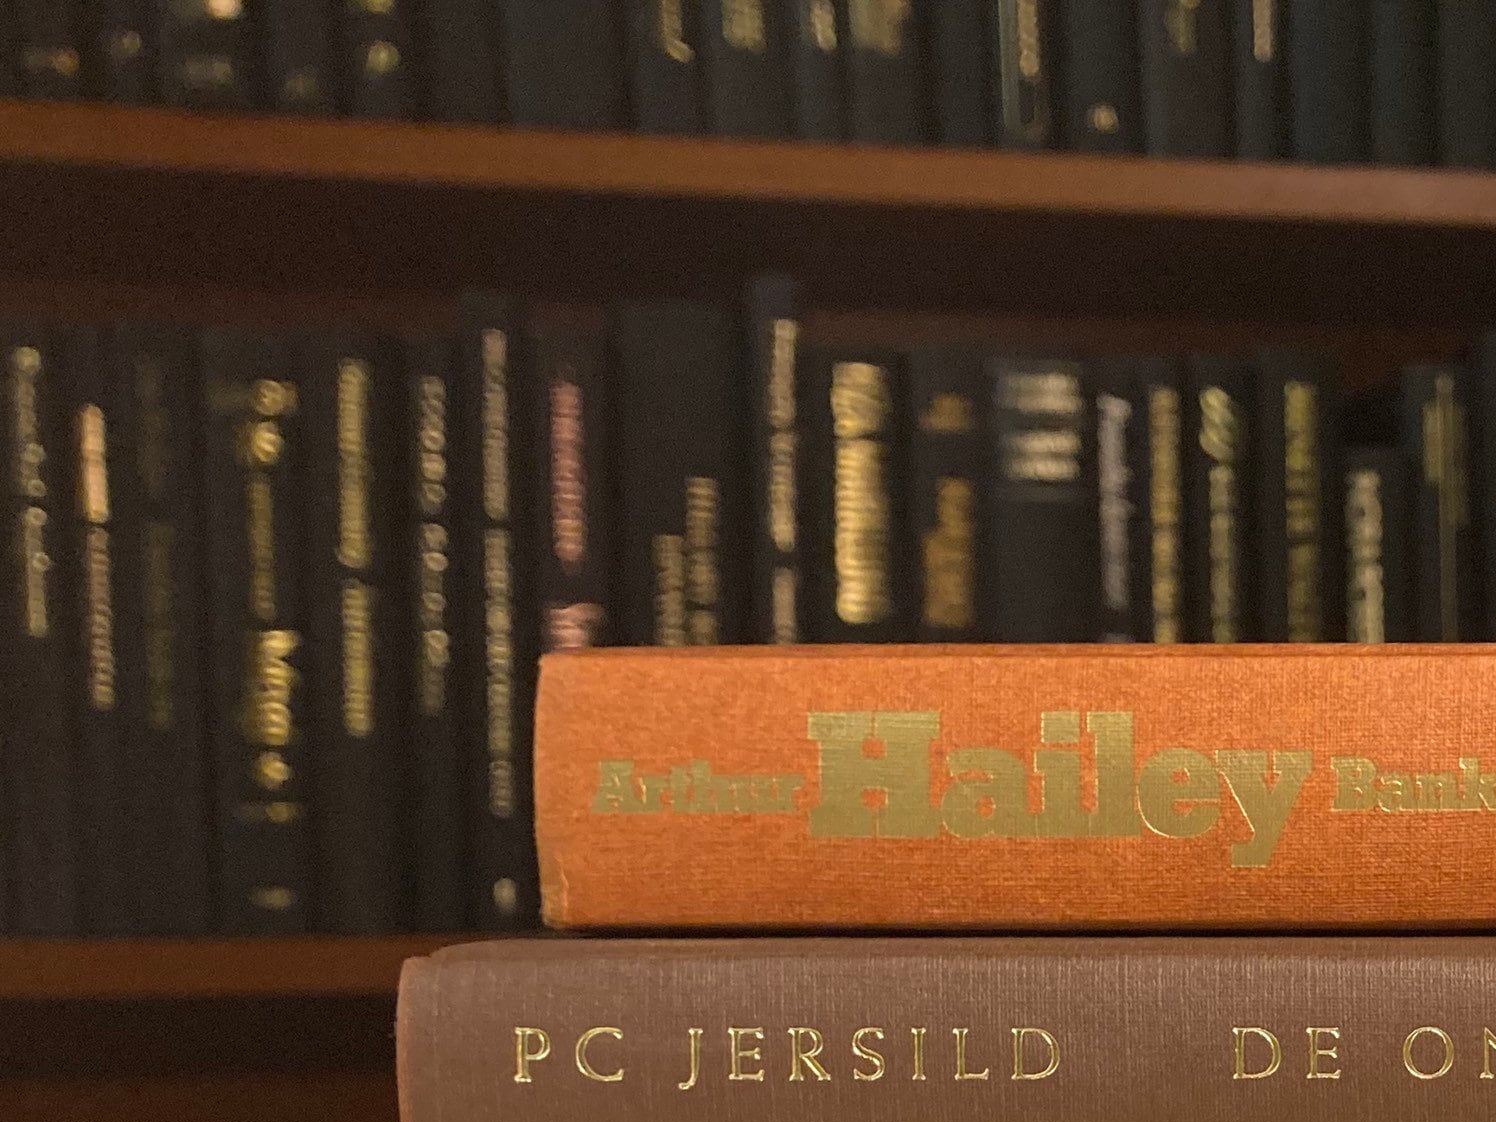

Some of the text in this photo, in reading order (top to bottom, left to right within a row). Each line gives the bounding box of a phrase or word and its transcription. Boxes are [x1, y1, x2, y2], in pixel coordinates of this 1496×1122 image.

[592, 760, 804, 814] Arthur
[808, 711, 1313, 867] Hailey
[678, 1027, 1060, 1090] JERSILD
[1232, 1027, 1341, 1081] DE
